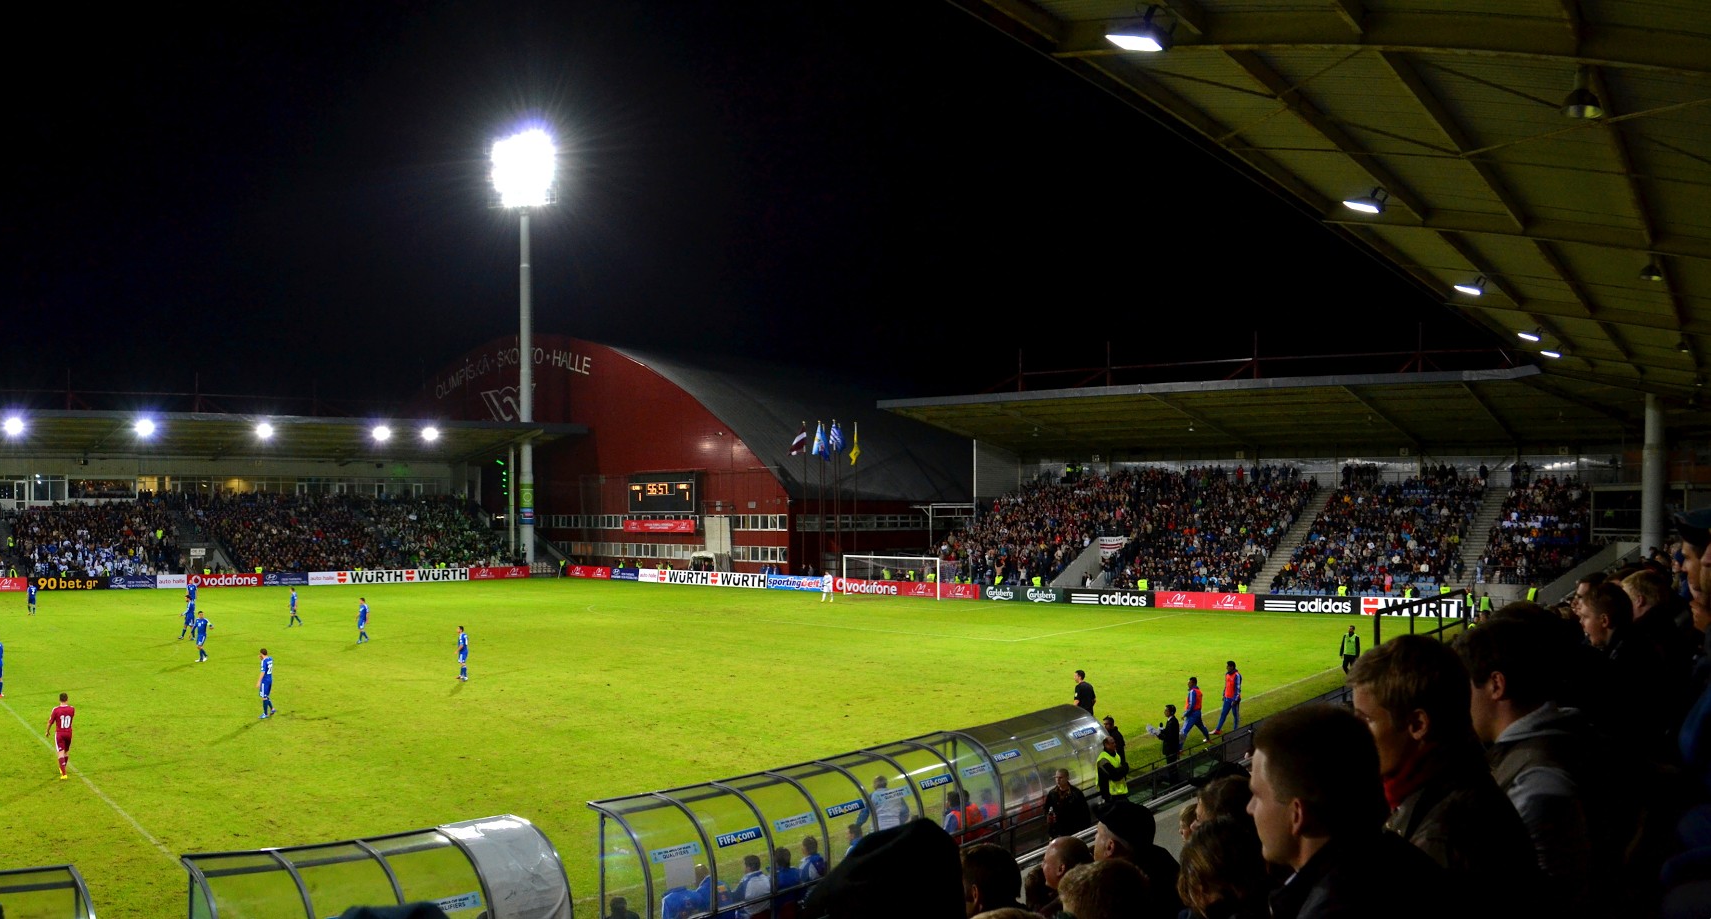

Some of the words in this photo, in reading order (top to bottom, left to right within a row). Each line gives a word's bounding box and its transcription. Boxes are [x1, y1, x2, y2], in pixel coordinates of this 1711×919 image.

[497, 347, 544, 367] SKOTO
[552, 349, 591, 375] HALLE
[203, 575, 258, 587] vodafone
[986, 587, 1013, 600] Carlsberg
[1027, 589, 1056, 602] Carlsberg
[1101, 592, 1147, 607] adidas
[1298, 598, 1351, 613] adidas
[60, 715, 71, 729] 10
[993, 751, 1017, 761] FIFA.com
[920, 776, 948, 789] FIFA.com
[827, 801, 860, 816] FIFA.com
[718, 830, 756, 847] FIFA.com
[662, 849, 689, 859] QUALIFIERS
